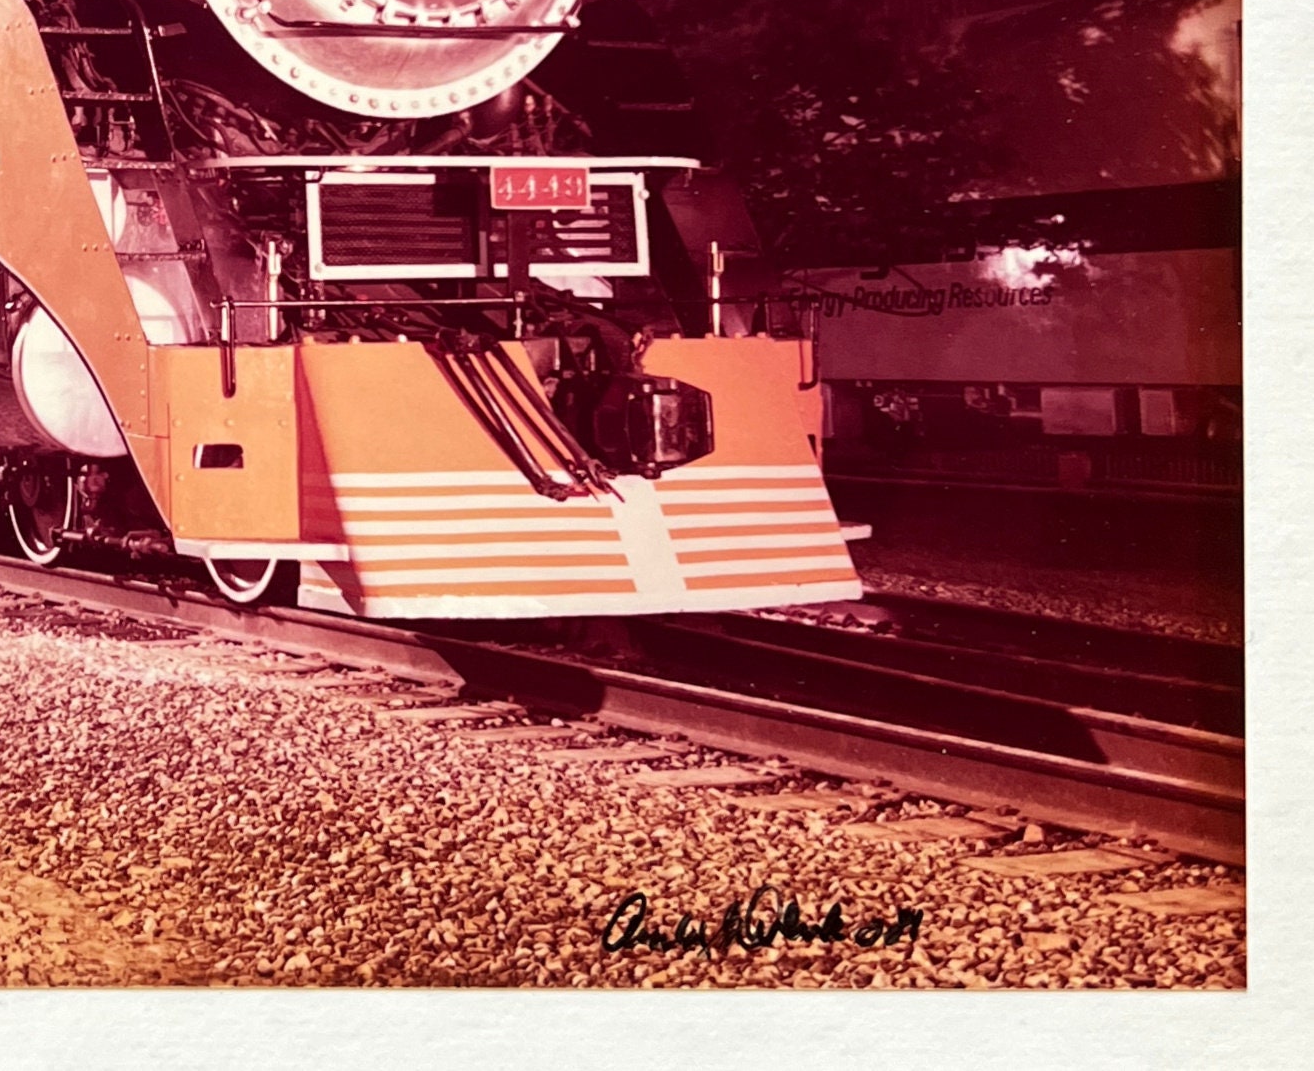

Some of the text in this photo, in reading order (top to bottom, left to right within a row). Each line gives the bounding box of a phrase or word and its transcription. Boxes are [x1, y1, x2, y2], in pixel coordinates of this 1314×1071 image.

[497, 174, 583, 201] 4449
[853, 285, 945, 316] Producing
[949, 282, 1054, 310] Resources
